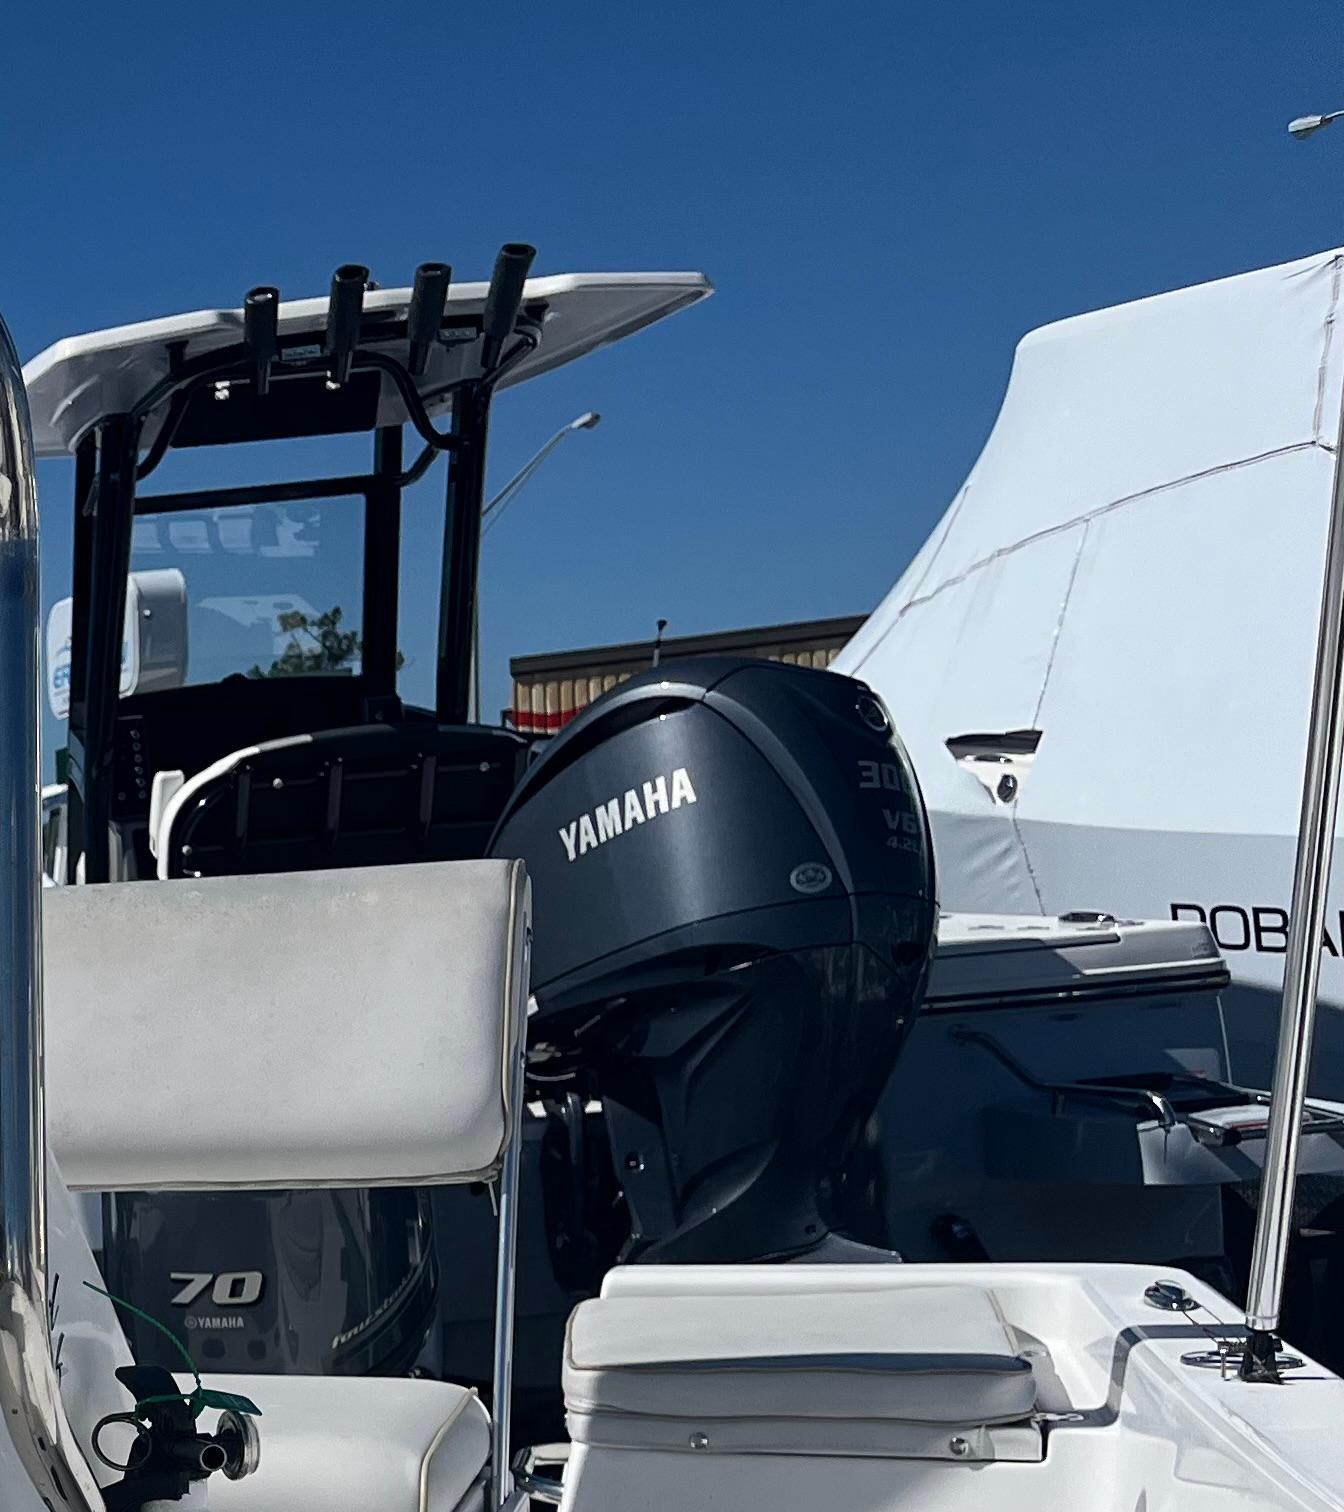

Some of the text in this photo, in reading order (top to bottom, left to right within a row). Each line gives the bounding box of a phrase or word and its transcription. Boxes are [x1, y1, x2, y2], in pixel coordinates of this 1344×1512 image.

[558, 767, 698, 863] YAMAHA
[169, 1271, 263, 1306] 70
[197, 1316, 244, 1329] YAMAHA
